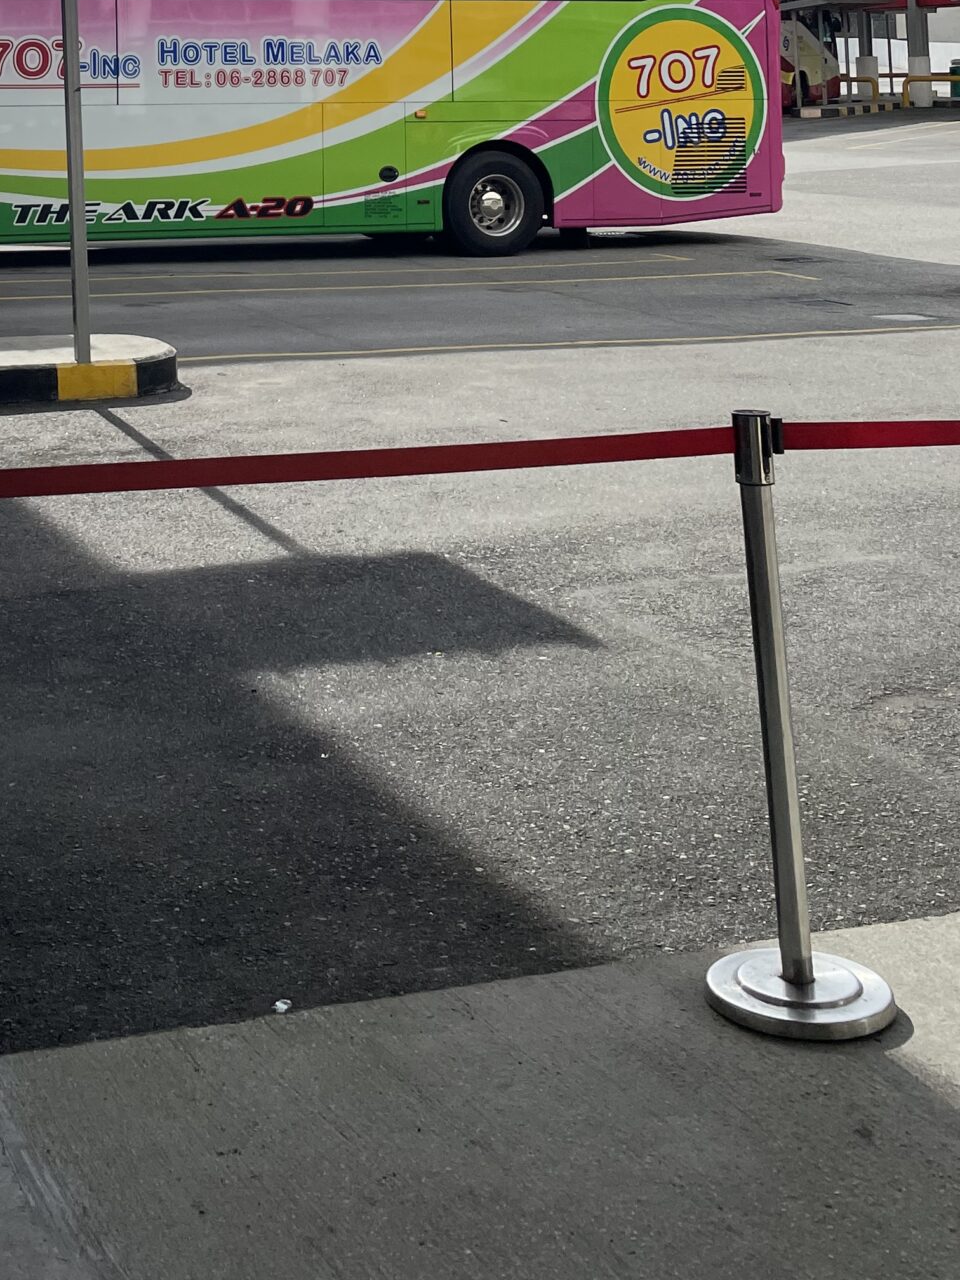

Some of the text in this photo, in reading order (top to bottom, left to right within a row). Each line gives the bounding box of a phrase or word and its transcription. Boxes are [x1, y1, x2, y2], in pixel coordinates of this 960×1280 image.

[157, 38, 383, 66] HOTEL MELAKA
[627, 44, 720, 98] 707
[102, 199, 212, 223] ARK
[213, 195, 316, 221] A-20
